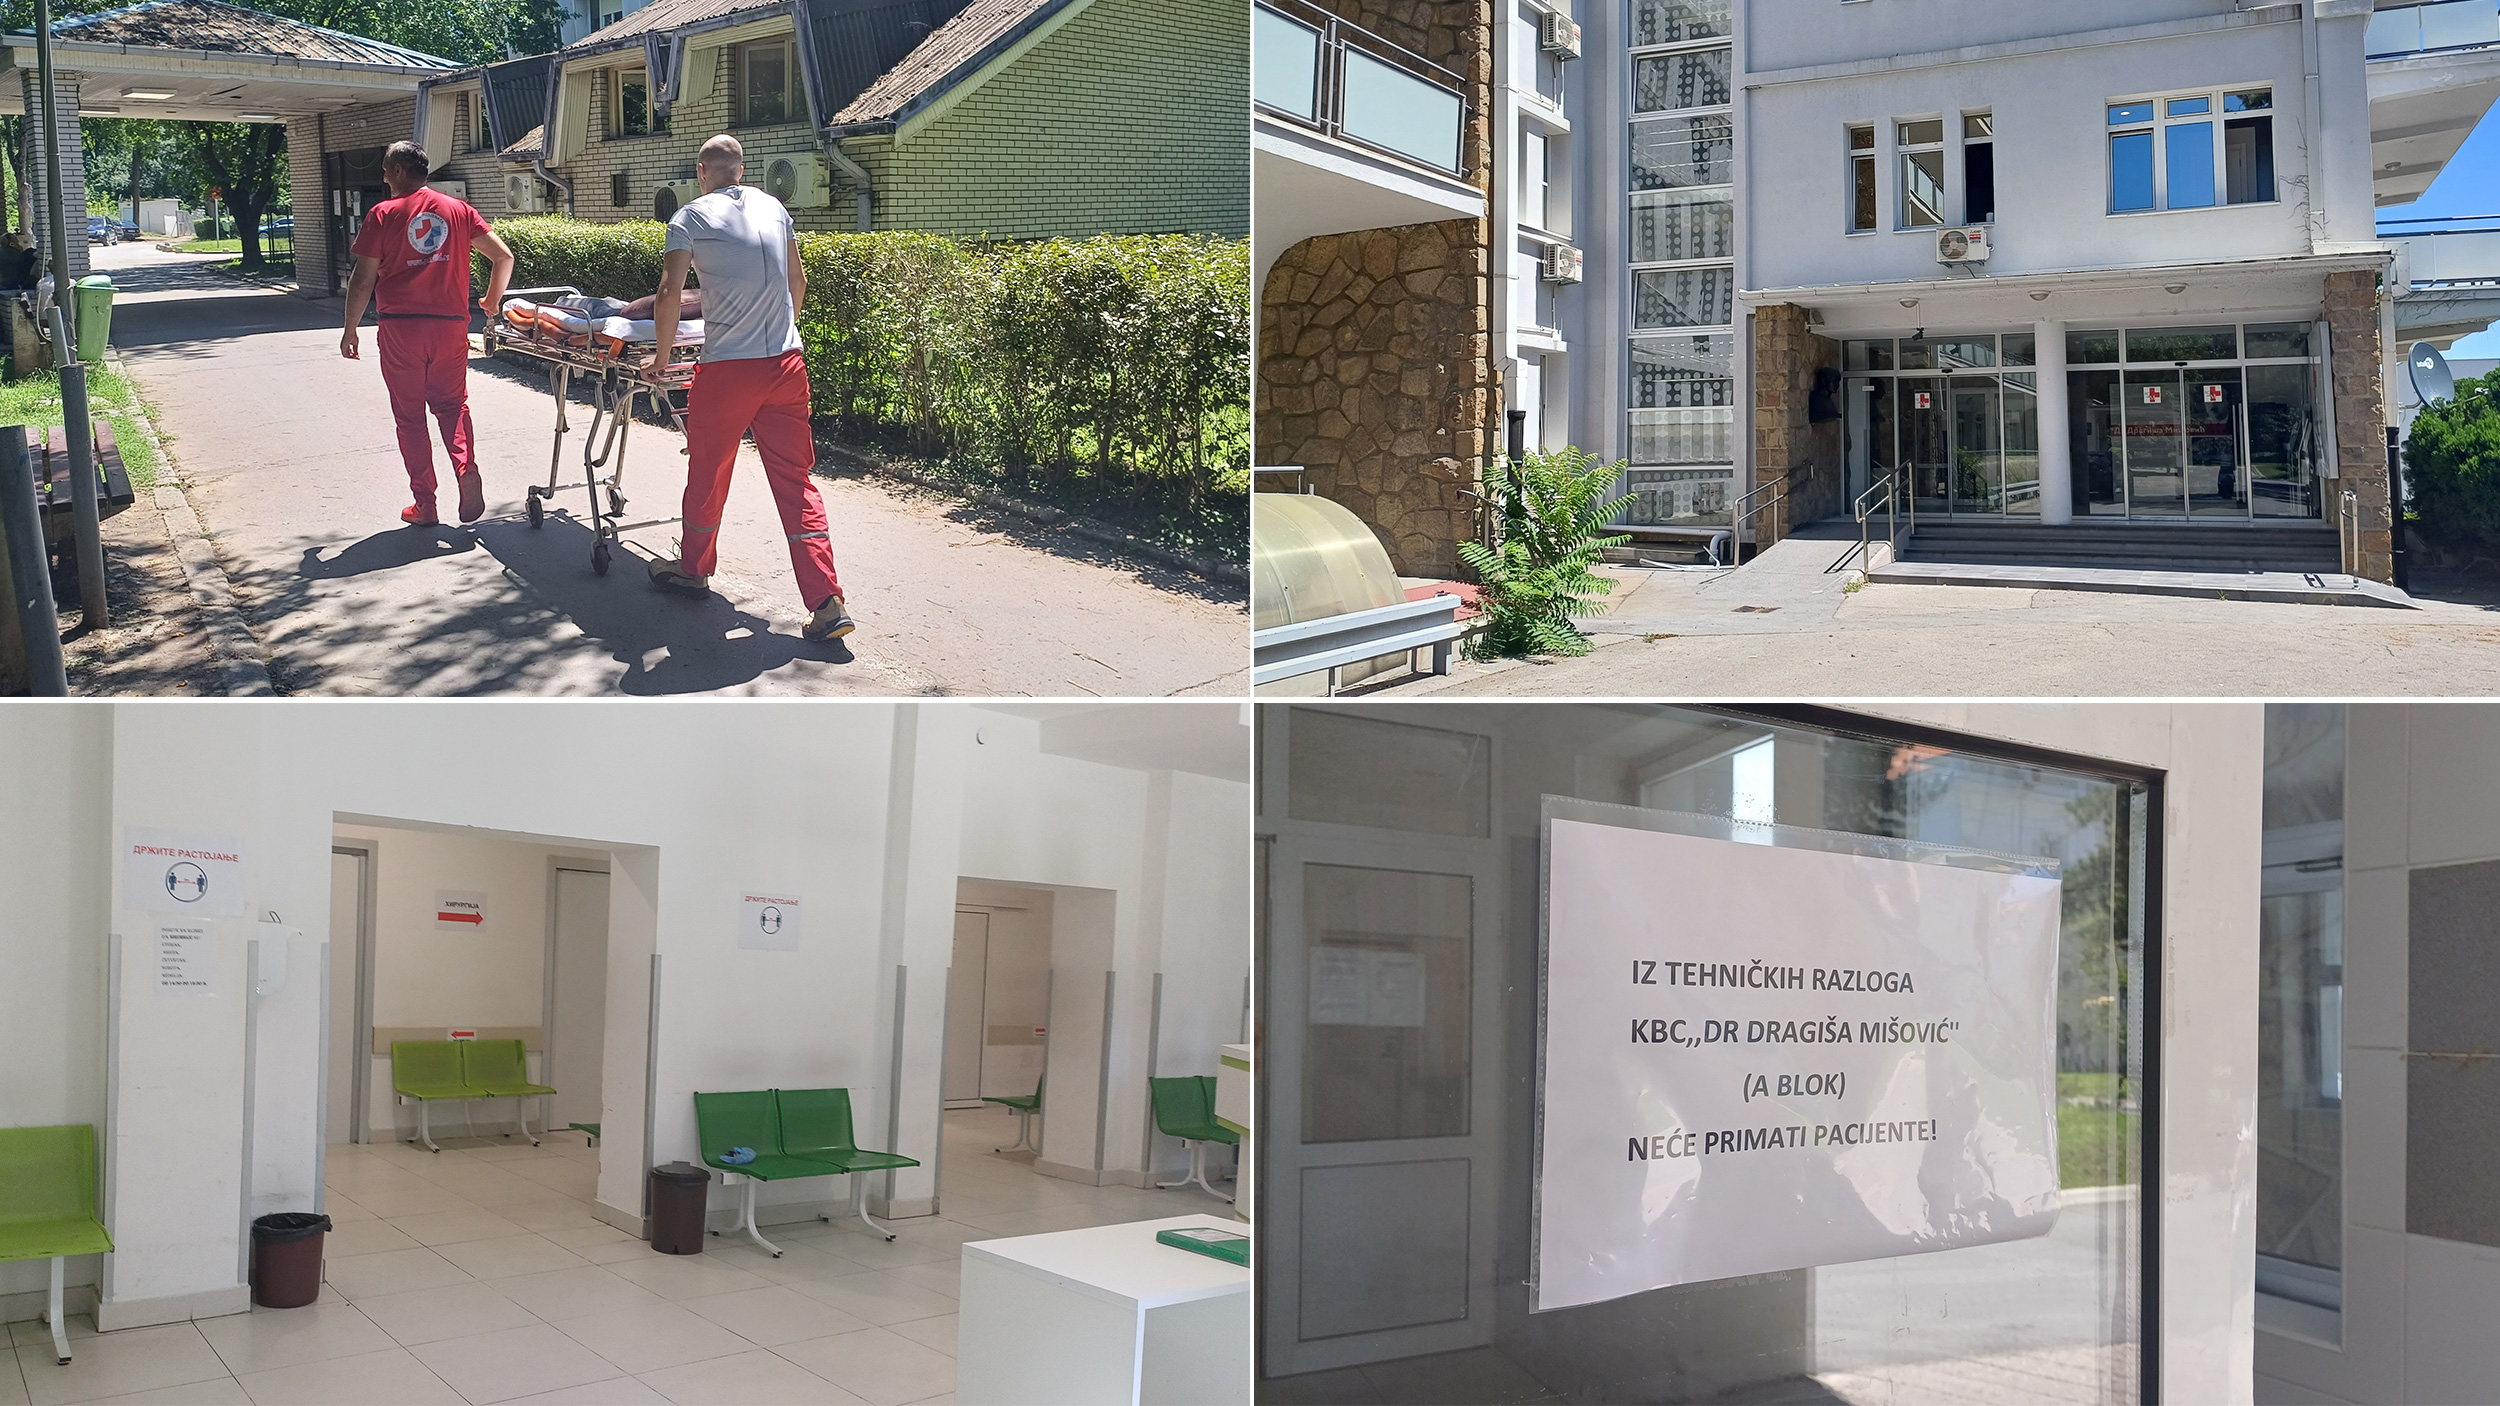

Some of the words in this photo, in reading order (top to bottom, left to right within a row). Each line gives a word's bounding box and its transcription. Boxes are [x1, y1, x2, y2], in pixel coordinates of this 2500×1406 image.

[133, 845, 176, 857] ДРЖИТЕ
[178, 849, 239, 862] РАСТОЈАЊЕ
[1632, 960, 1657, 985] IZ
[1665, 959, 1804, 990] TEHNIČKIH
[1812, 968, 1914, 993] RAZLOGA
[1747, 1015, 1853, 1044] DRAGIŠA
[1743, 1073, 1769, 1102] (A
[1777, 1071, 1846, 1100] BLOK)
[1628, 1127, 1697, 1161] NEĆE
[1704, 1125, 1806, 1155] PRIMATI
[1814, 1119, 1938, 1146] PACIJENTE!
